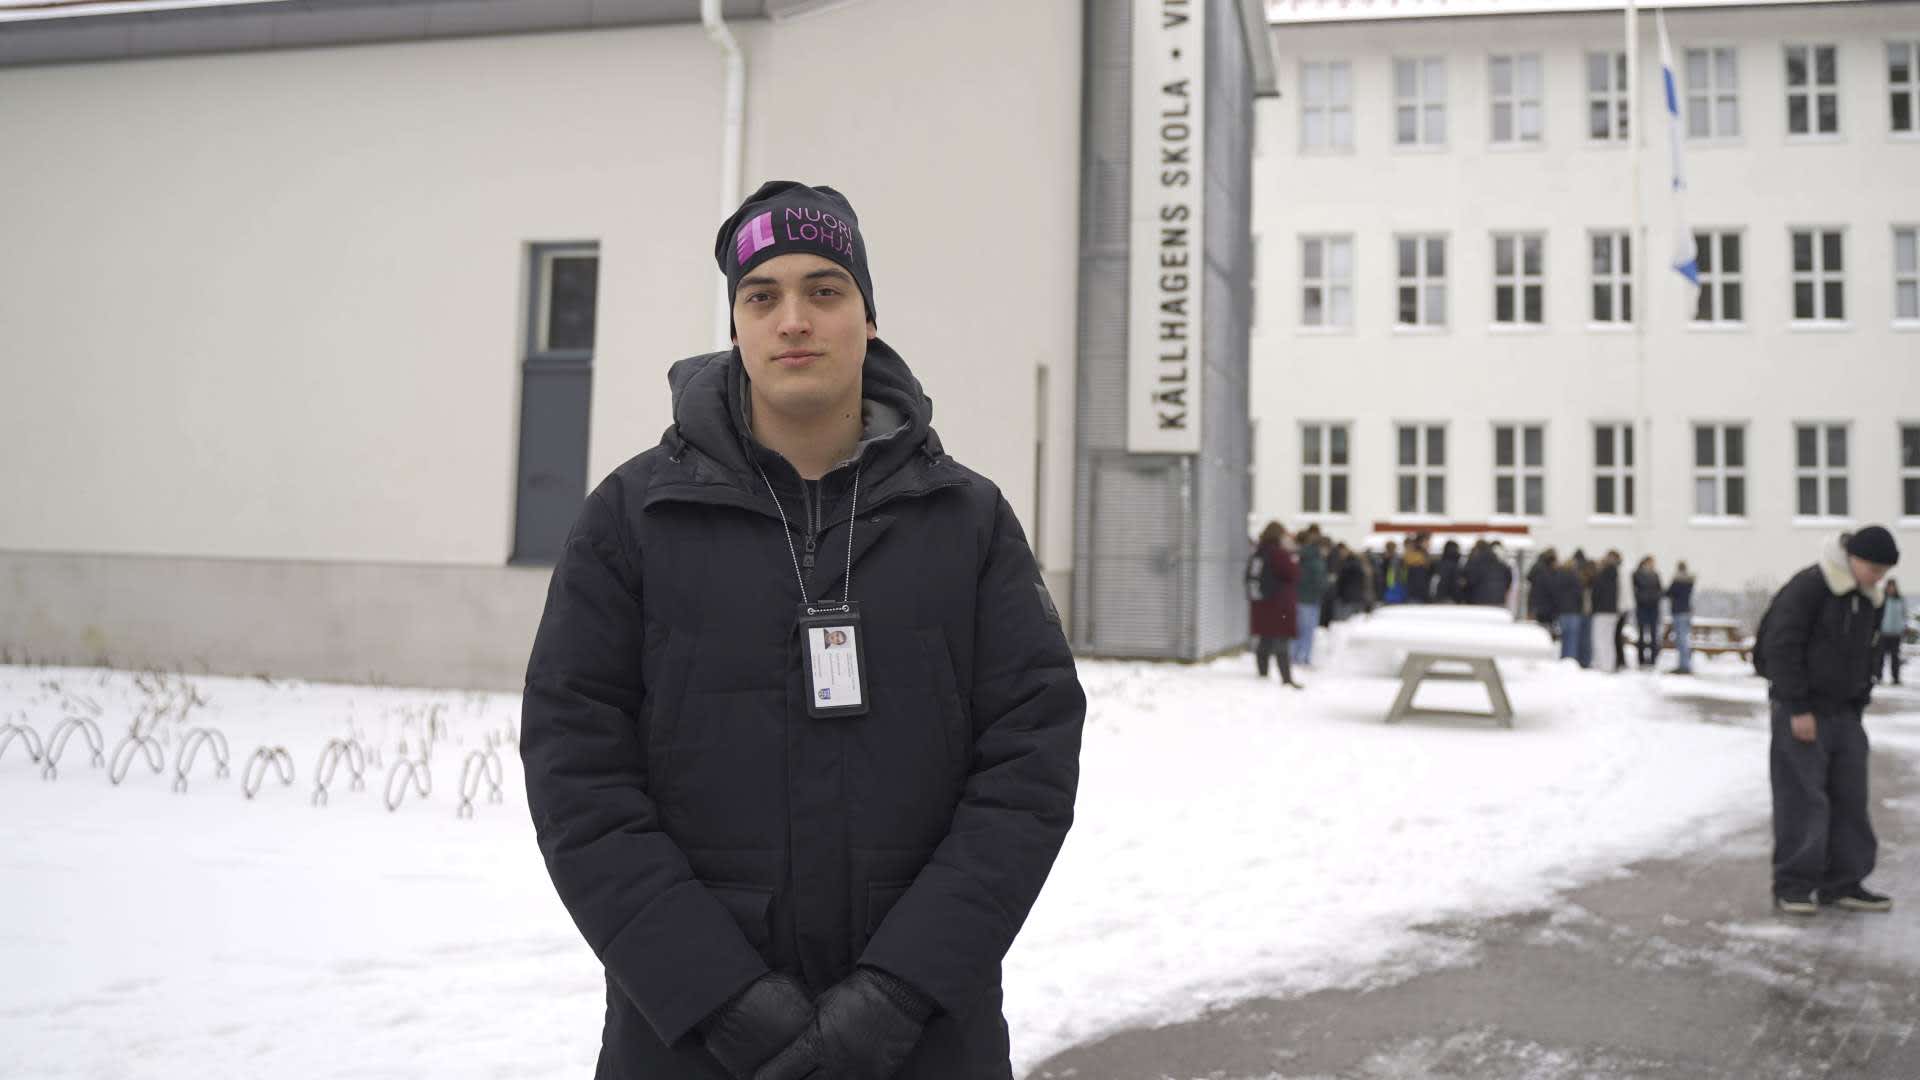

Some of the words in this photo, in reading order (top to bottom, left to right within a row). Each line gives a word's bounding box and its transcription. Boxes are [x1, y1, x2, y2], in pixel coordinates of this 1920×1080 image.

[1161, 79, 1190, 187] SKOLA
[785, 207, 852, 242] NUORI
[786, 223, 853, 264] LOHJA
[1152, 204, 1190, 430] KÄLLHAGENS
